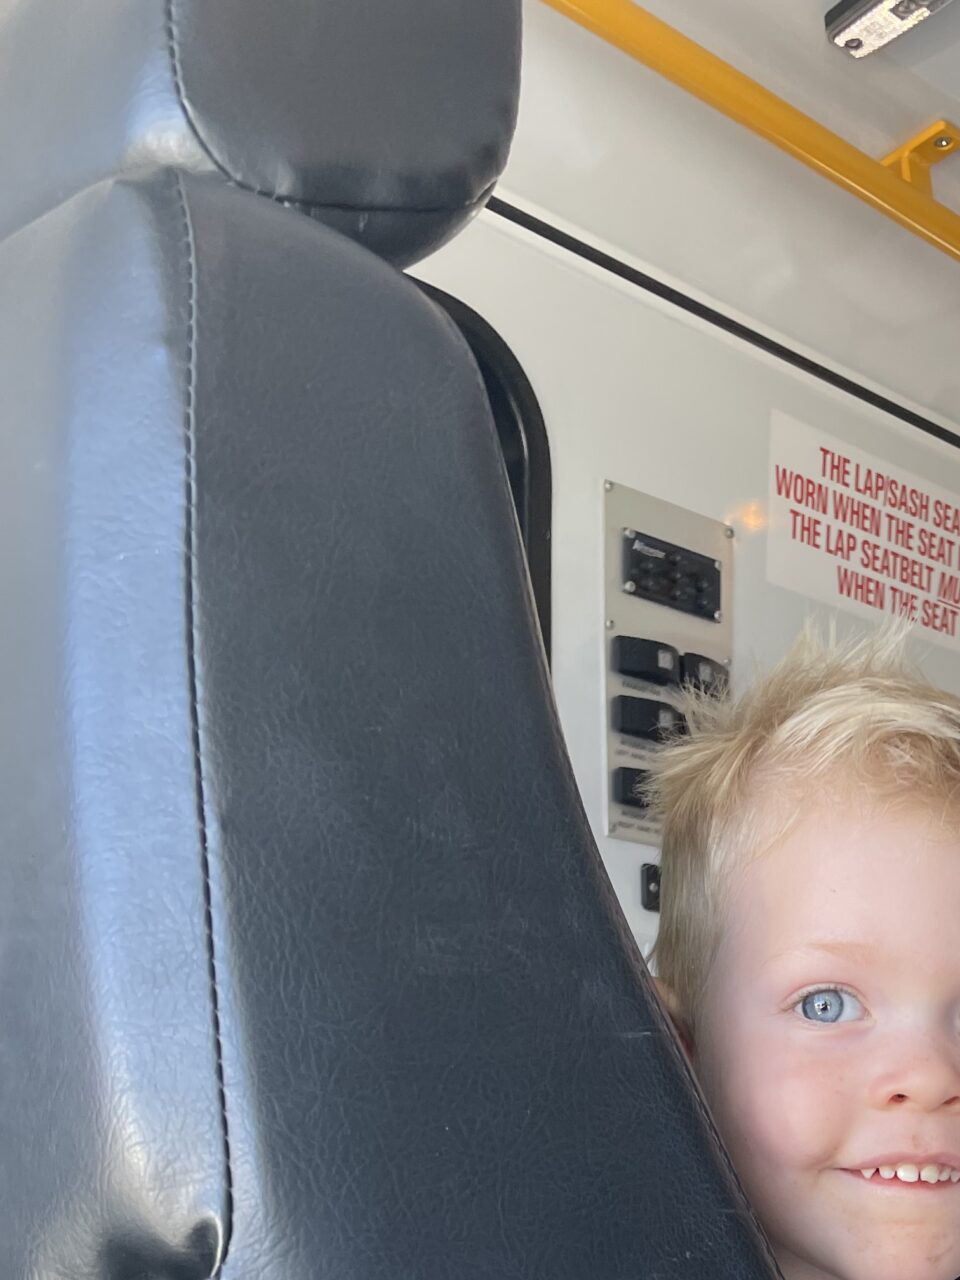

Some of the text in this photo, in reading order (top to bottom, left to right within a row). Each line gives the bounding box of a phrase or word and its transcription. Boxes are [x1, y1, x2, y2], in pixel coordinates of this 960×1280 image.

[819, 446, 850, 488] THE
[775, 464, 828, 515] WORN
[833, 490, 881, 537] WHEN
[885, 513, 915, 551] THE
[918, 528, 955, 567] SEAT
[790, 508, 821, 549] THE
[825, 524, 856, 561] LAP
[860, 539, 934, 593] SEATBELT
[837, 564, 885, 610] WHEN
[889, 586, 918, 622] THE
[921, 599, 958, 637] SEAT
